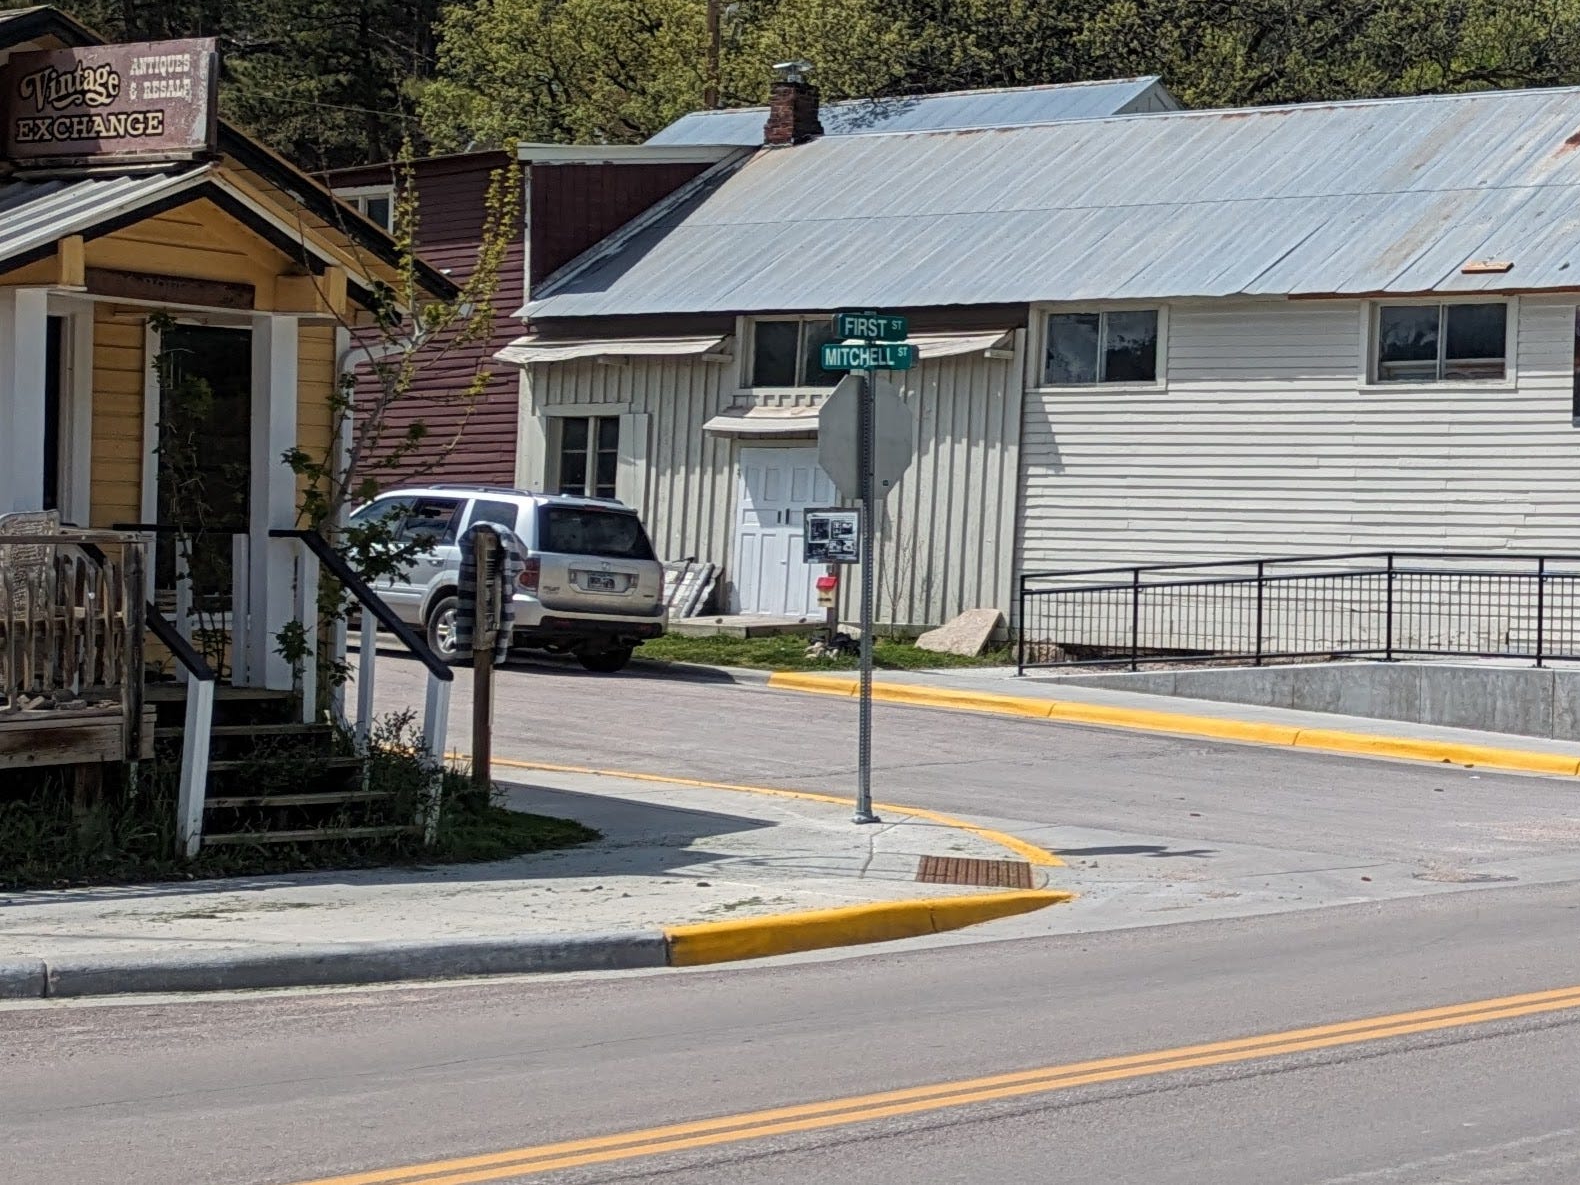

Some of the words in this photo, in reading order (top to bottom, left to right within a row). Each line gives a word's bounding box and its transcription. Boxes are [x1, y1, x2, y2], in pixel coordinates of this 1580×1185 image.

[130, 54, 190, 76] ANTIQUES
[20, 61, 119, 110] Vintage
[16, 111, 163, 141] EXCHANGE
[844, 317, 887, 337] FIRST
[891, 320, 902, 330] ST
[825, 347, 895, 366] MITCHELL
[898, 347, 908, 356] ST
